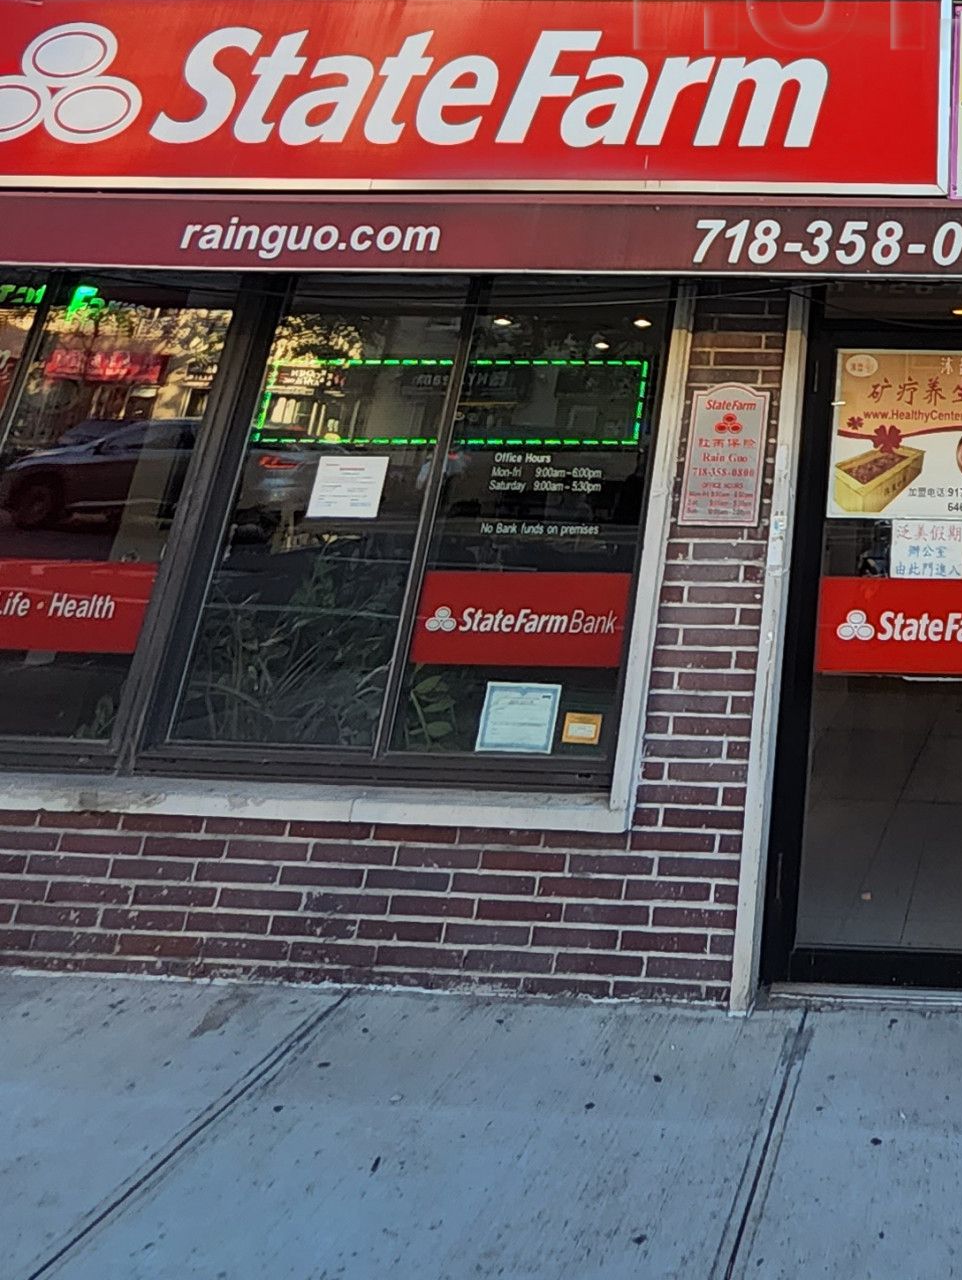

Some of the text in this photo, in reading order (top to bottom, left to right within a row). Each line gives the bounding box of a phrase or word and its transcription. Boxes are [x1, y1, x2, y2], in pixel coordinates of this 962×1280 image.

[179, 217, 441, 257] rainguo.com
[494, 451, 552, 464] Office Hours
[703, 451, 726, 463] Rain
[488, 479, 527, 493] Saturday
[480, 522, 600, 537] No Bank funds on premises
[897, 524, 962, 542] 泛美假期
[48, 592, 116, 619] Health
[568, 607, 618, 635] Bank
